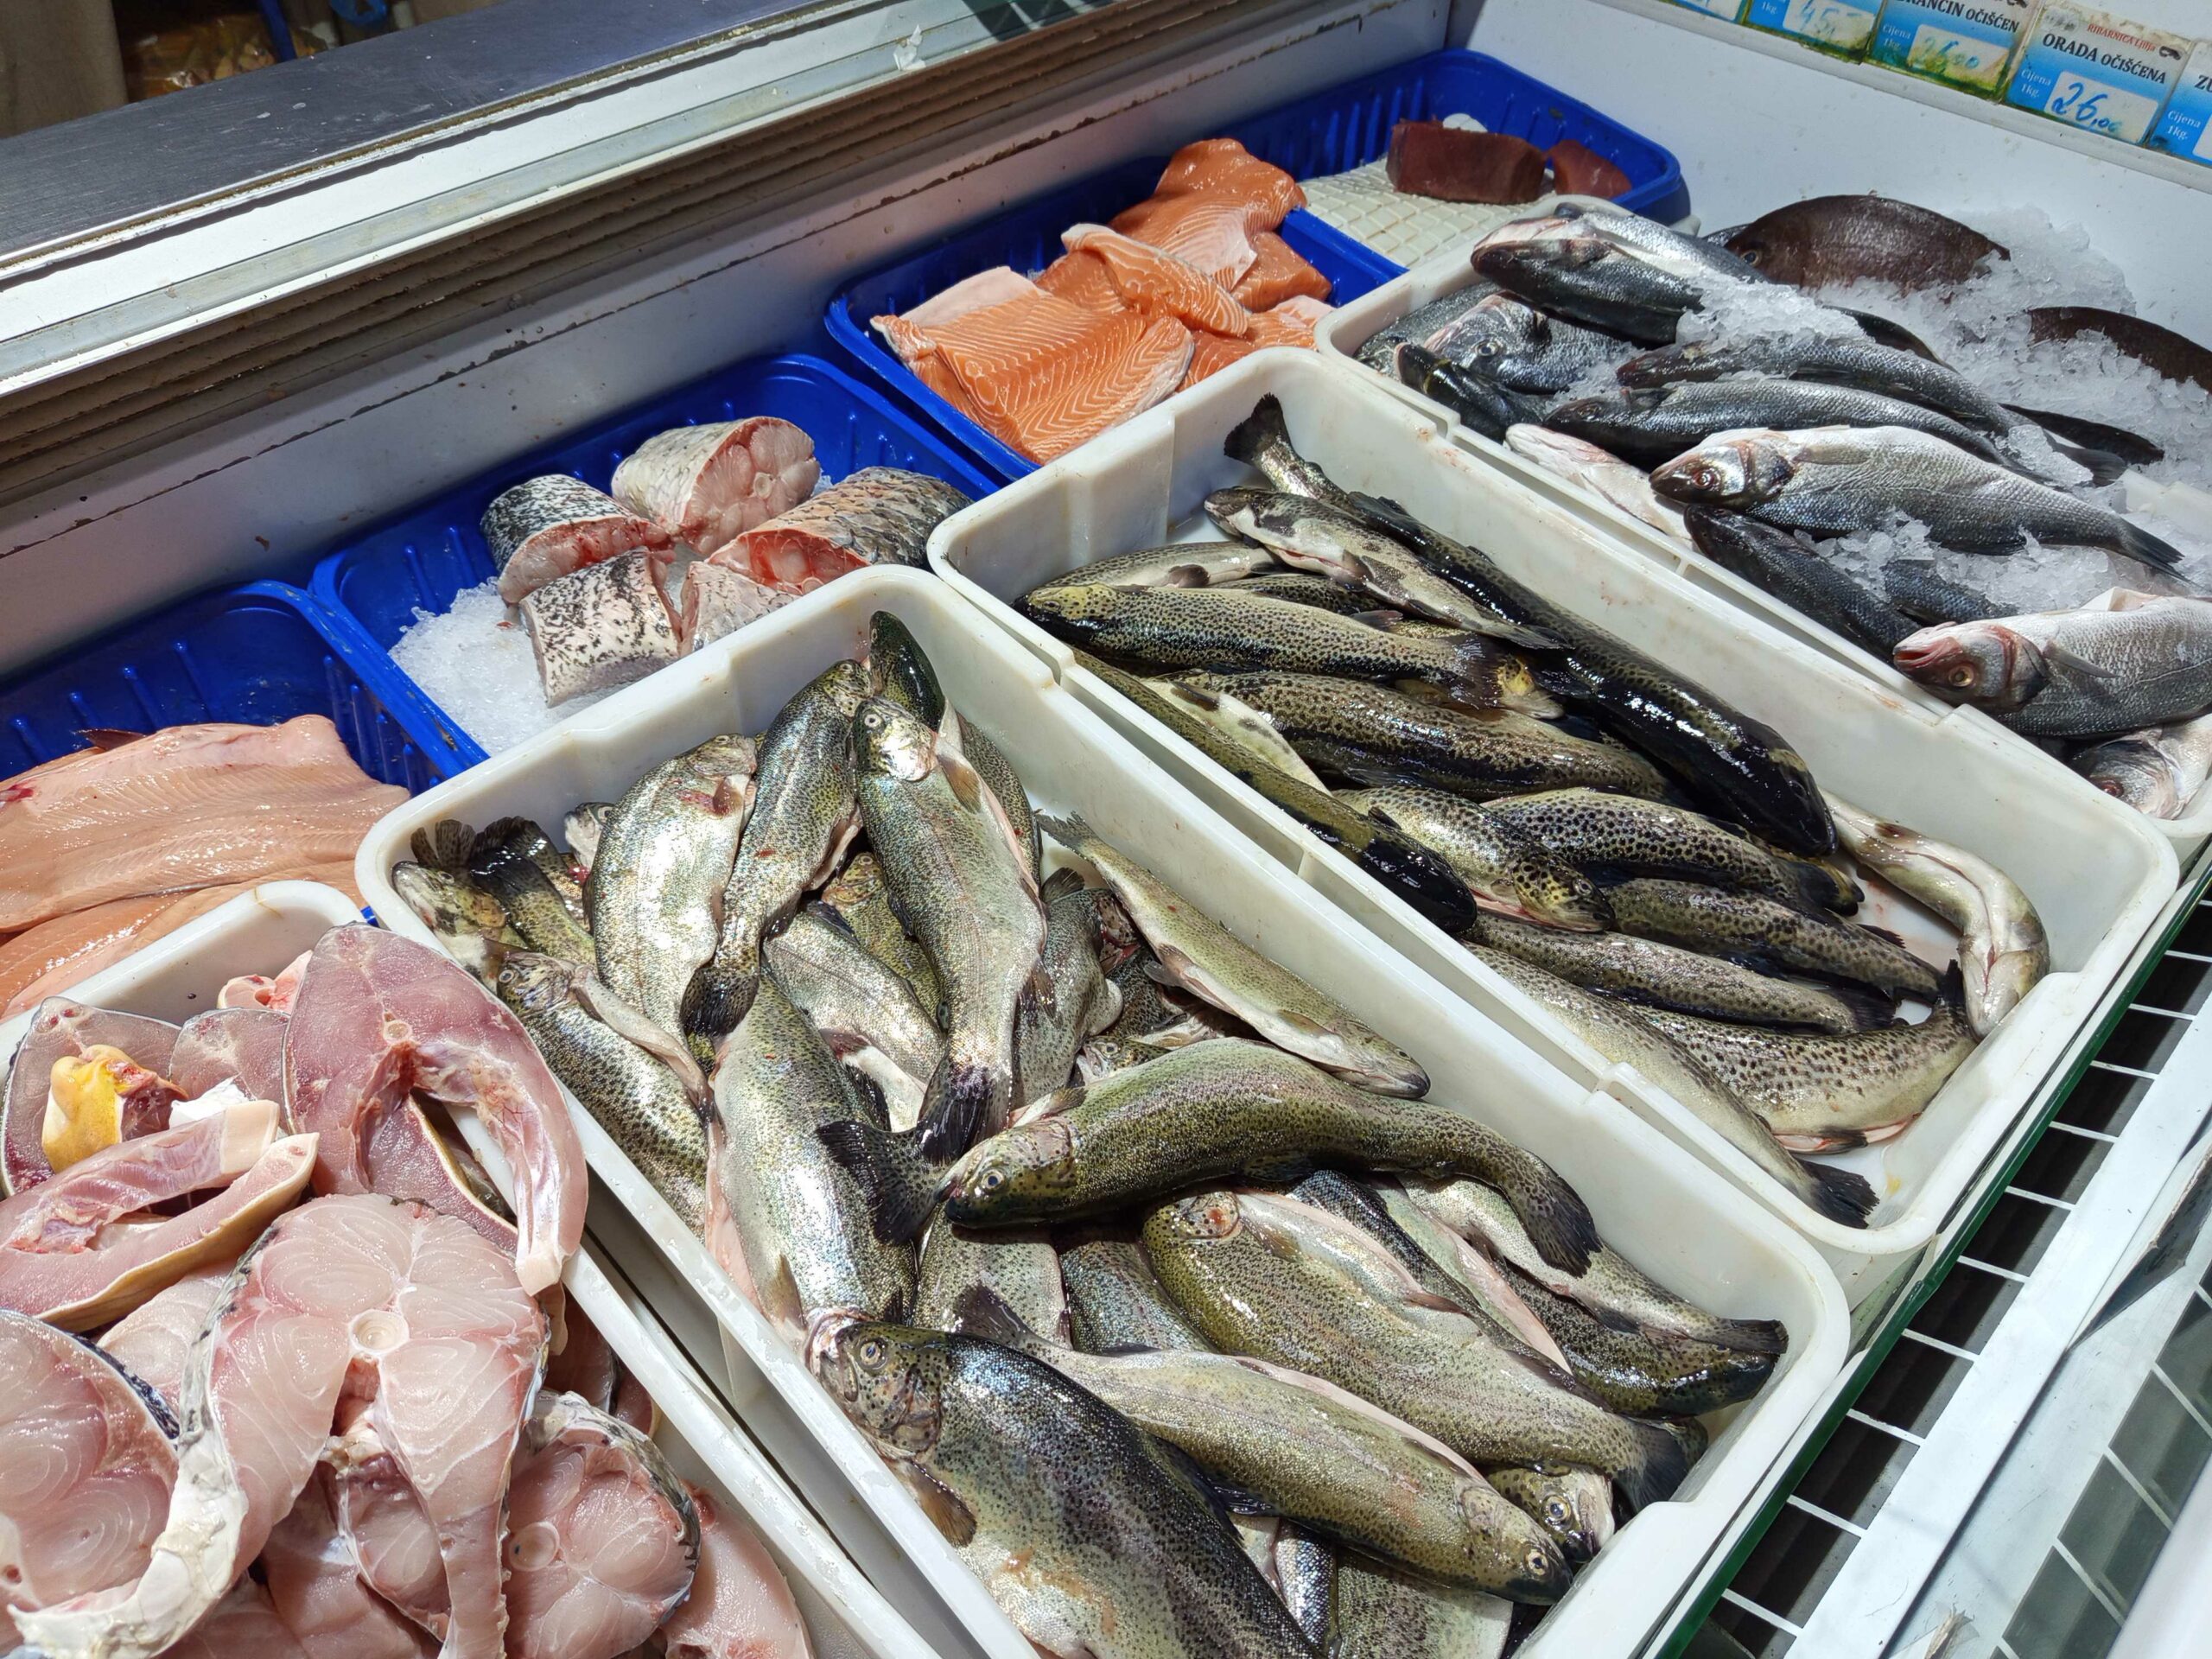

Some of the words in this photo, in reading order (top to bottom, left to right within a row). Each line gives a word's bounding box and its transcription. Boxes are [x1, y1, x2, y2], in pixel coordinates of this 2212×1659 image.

[1965, 8, 2020, 33] OČIŠĆEN
[1882, 24, 1911, 40] Cijena
[2087, 23, 2134, 44] RIBARNICA
[2042, 33, 2098, 62] ORADA
[2101, 53, 2167, 85] OČIŠĆENA
[2021, 69, 2052, 86] Cijena
[2167, 110, 2201, 128] Cijena
